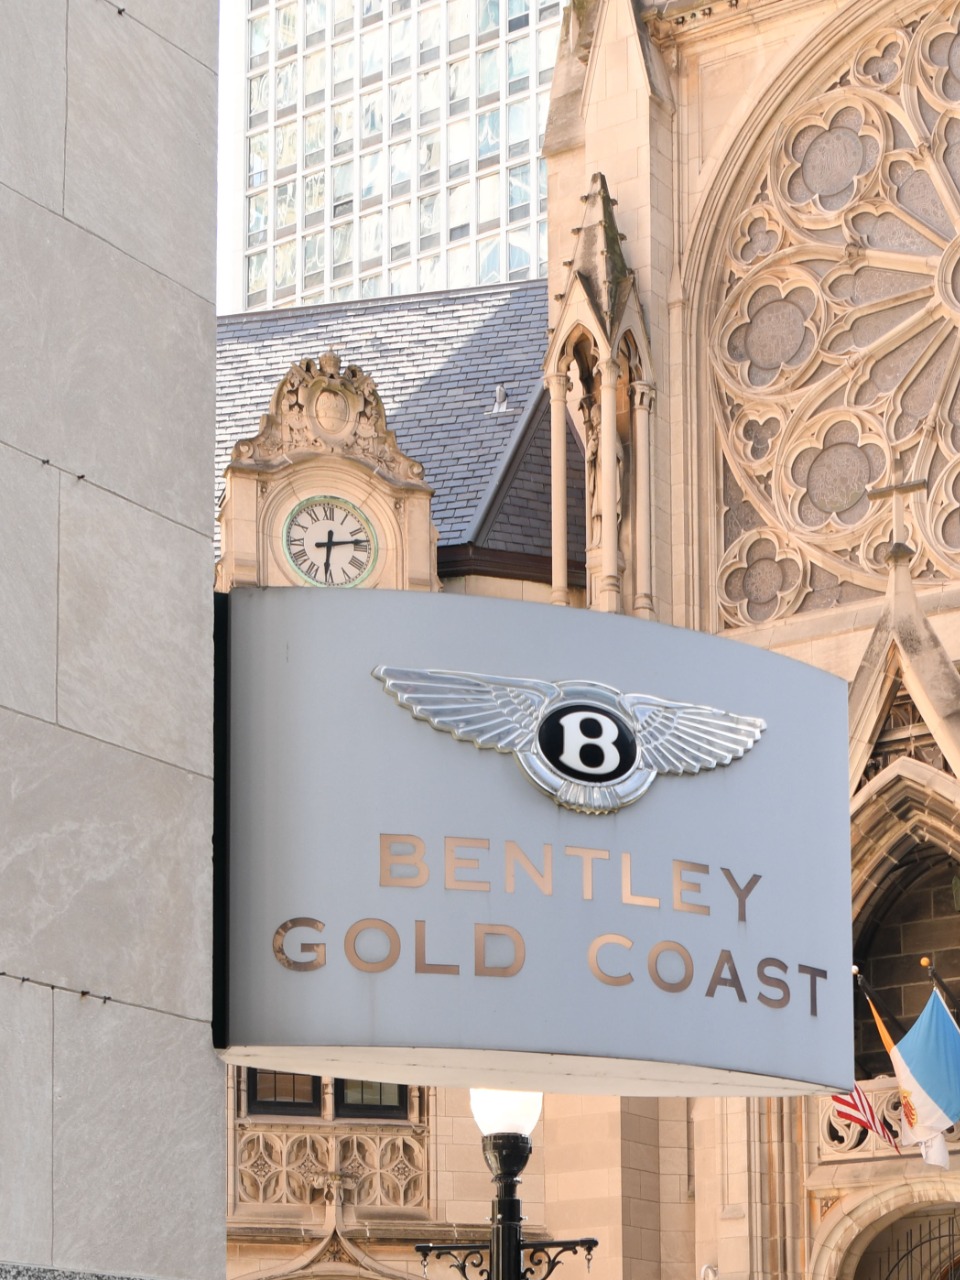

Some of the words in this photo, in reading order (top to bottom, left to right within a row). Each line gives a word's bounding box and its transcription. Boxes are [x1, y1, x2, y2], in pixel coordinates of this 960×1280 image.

[322, 506, 335, 521] XII
[560, 710, 620, 776] B
[379, 833, 763, 922] BENTLEY
[272, 917, 527, 978] GOLD
[587, 933, 828, 1017] COAST
